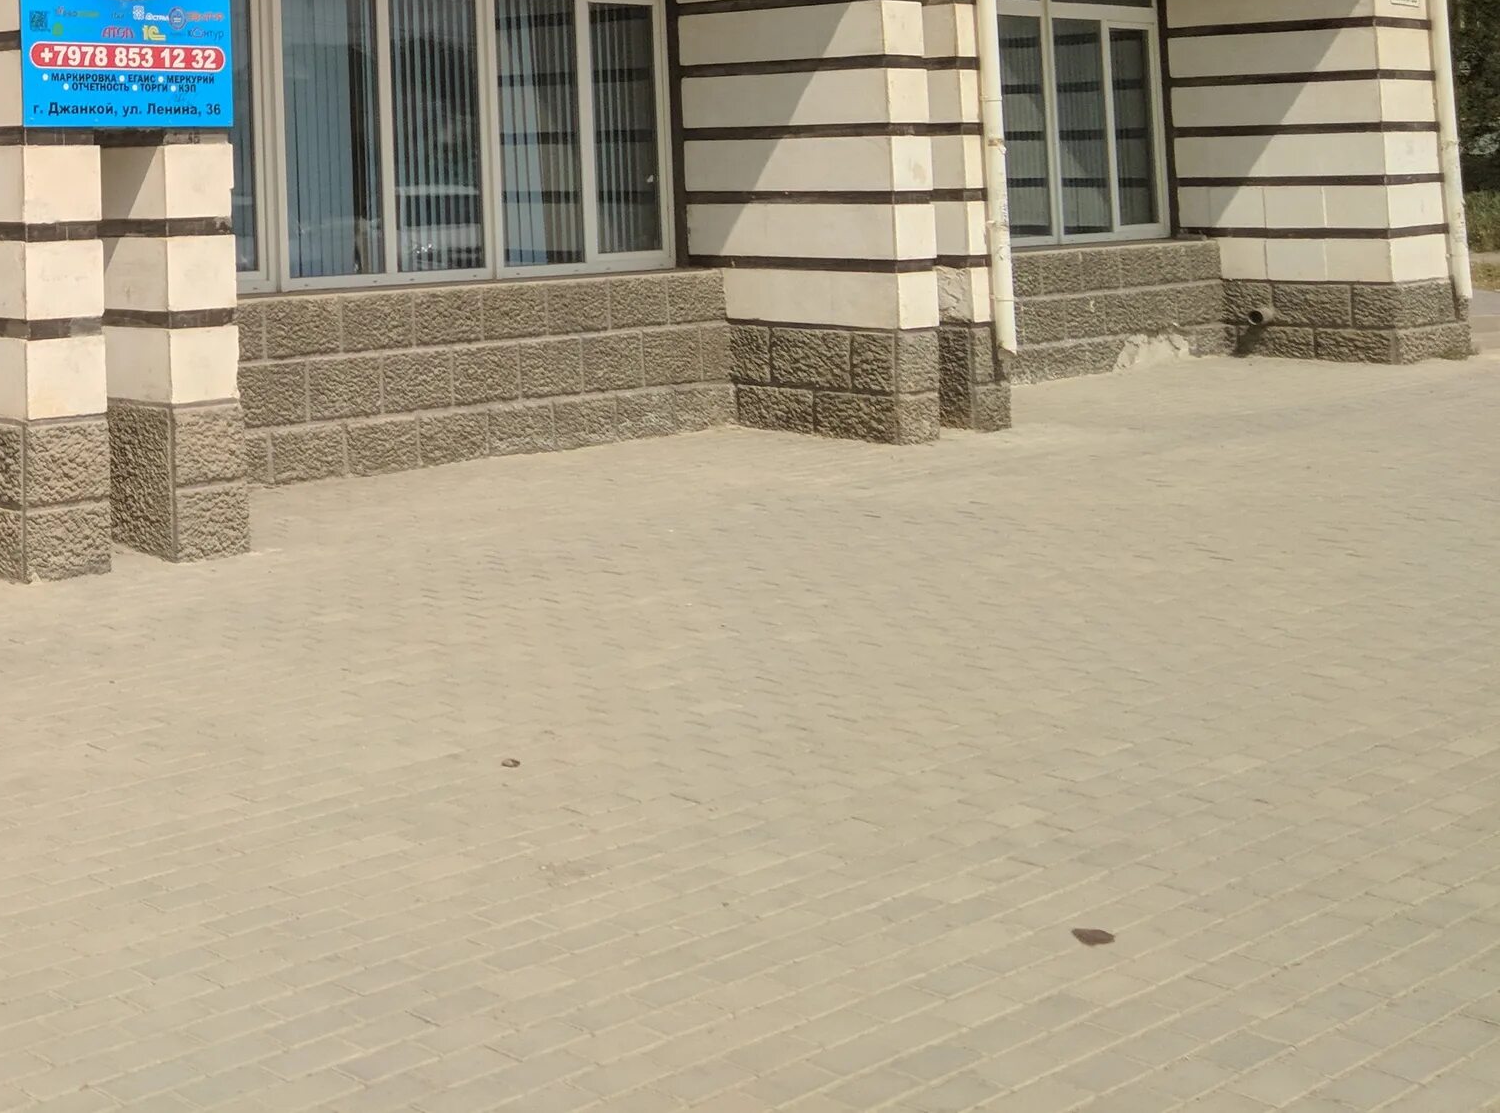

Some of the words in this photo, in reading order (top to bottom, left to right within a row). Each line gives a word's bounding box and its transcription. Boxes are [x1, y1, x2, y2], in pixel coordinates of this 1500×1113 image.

[40, 46, 108, 67] +7978
[114, 47, 153, 68] 853
[160, 48, 185, 68] 12
[191, 49, 216, 69] 32
[51, 73, 117, 83] МАРКИРОВКА
[128, 74, 156, 83] ЕГАИС
[166, 73, 214, 83] МЕРКУРИЙ
[71, 83, 129, 92] ОТЧЕТНОСТЬ
[140, 84, 168, 92] ТОРГИ
[179, 84, 196, 92] КЭП
[33, 105, 43, 115] г.
[48, 101, 118, 118] Джанкой,
[123, 105, 142, 118] ул.
[147, 103, 201, 118] Ленина,
[206, 103, 221, 115] 36
